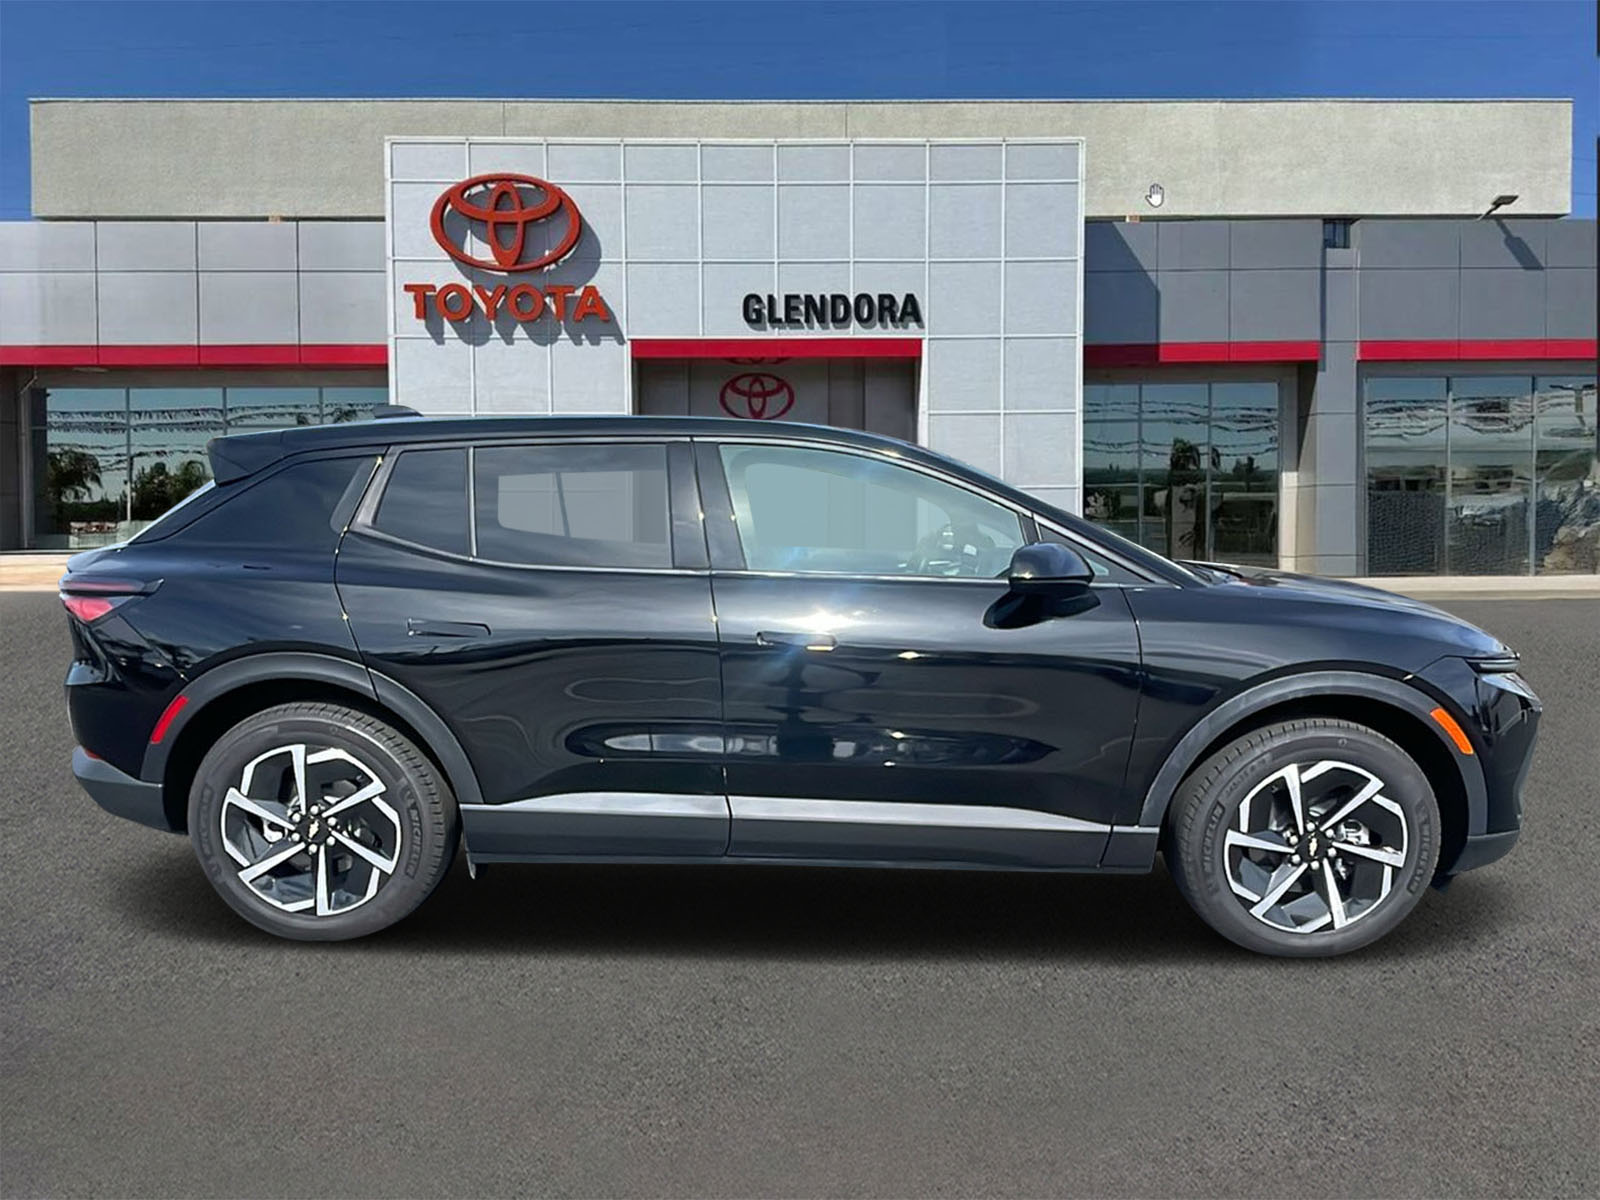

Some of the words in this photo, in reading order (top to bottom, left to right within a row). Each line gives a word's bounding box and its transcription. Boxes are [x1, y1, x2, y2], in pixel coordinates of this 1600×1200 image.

[404, 283, 610, 324] TOYOTA
[742, 292, 922, 326] GLENDORA
[407, 808, 421, 876] MICHELIN
[1203, 803, 1224, 873] MICHELIN
